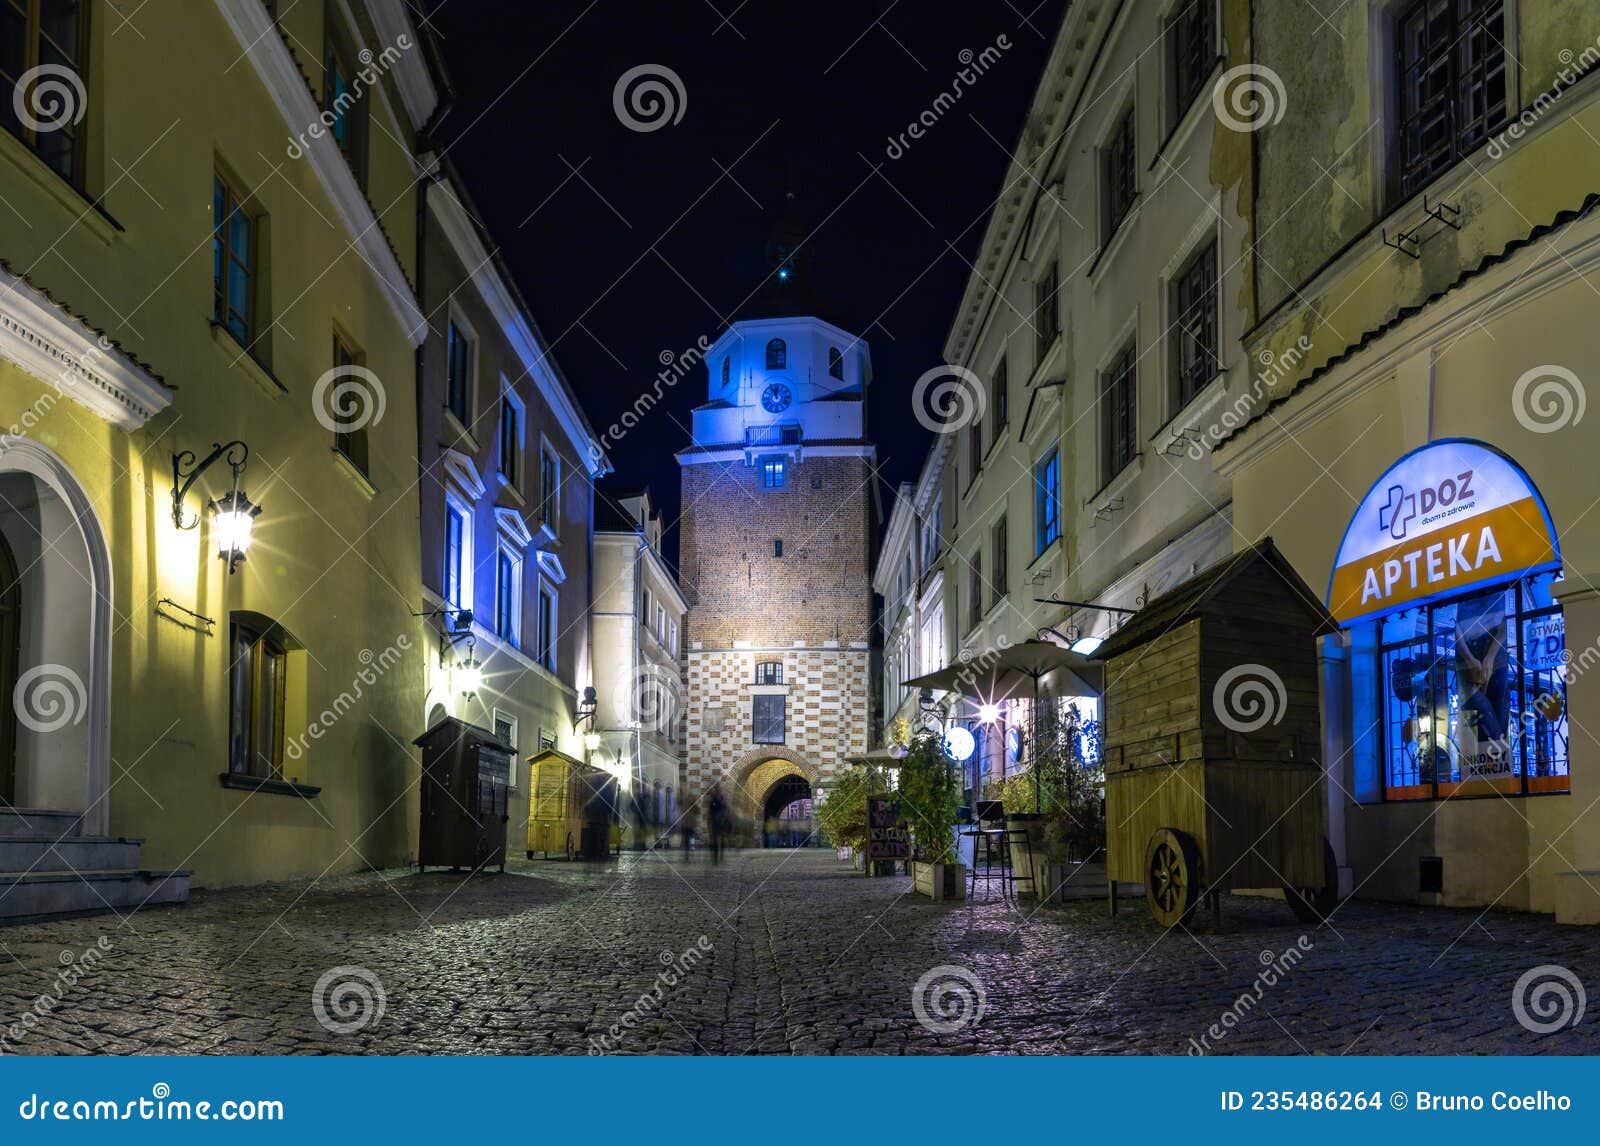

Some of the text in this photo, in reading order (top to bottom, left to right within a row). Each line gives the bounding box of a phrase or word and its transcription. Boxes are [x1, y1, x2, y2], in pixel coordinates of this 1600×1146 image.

[1420, 470, 1475, 515] DOZ
[1421, 514, 1441, 525] dbam
[1447, 501, 1475, 516] zdrowie
[1360, 525, 1503, 606] APTEKA
[1529, 638, 1540, 657] 7
